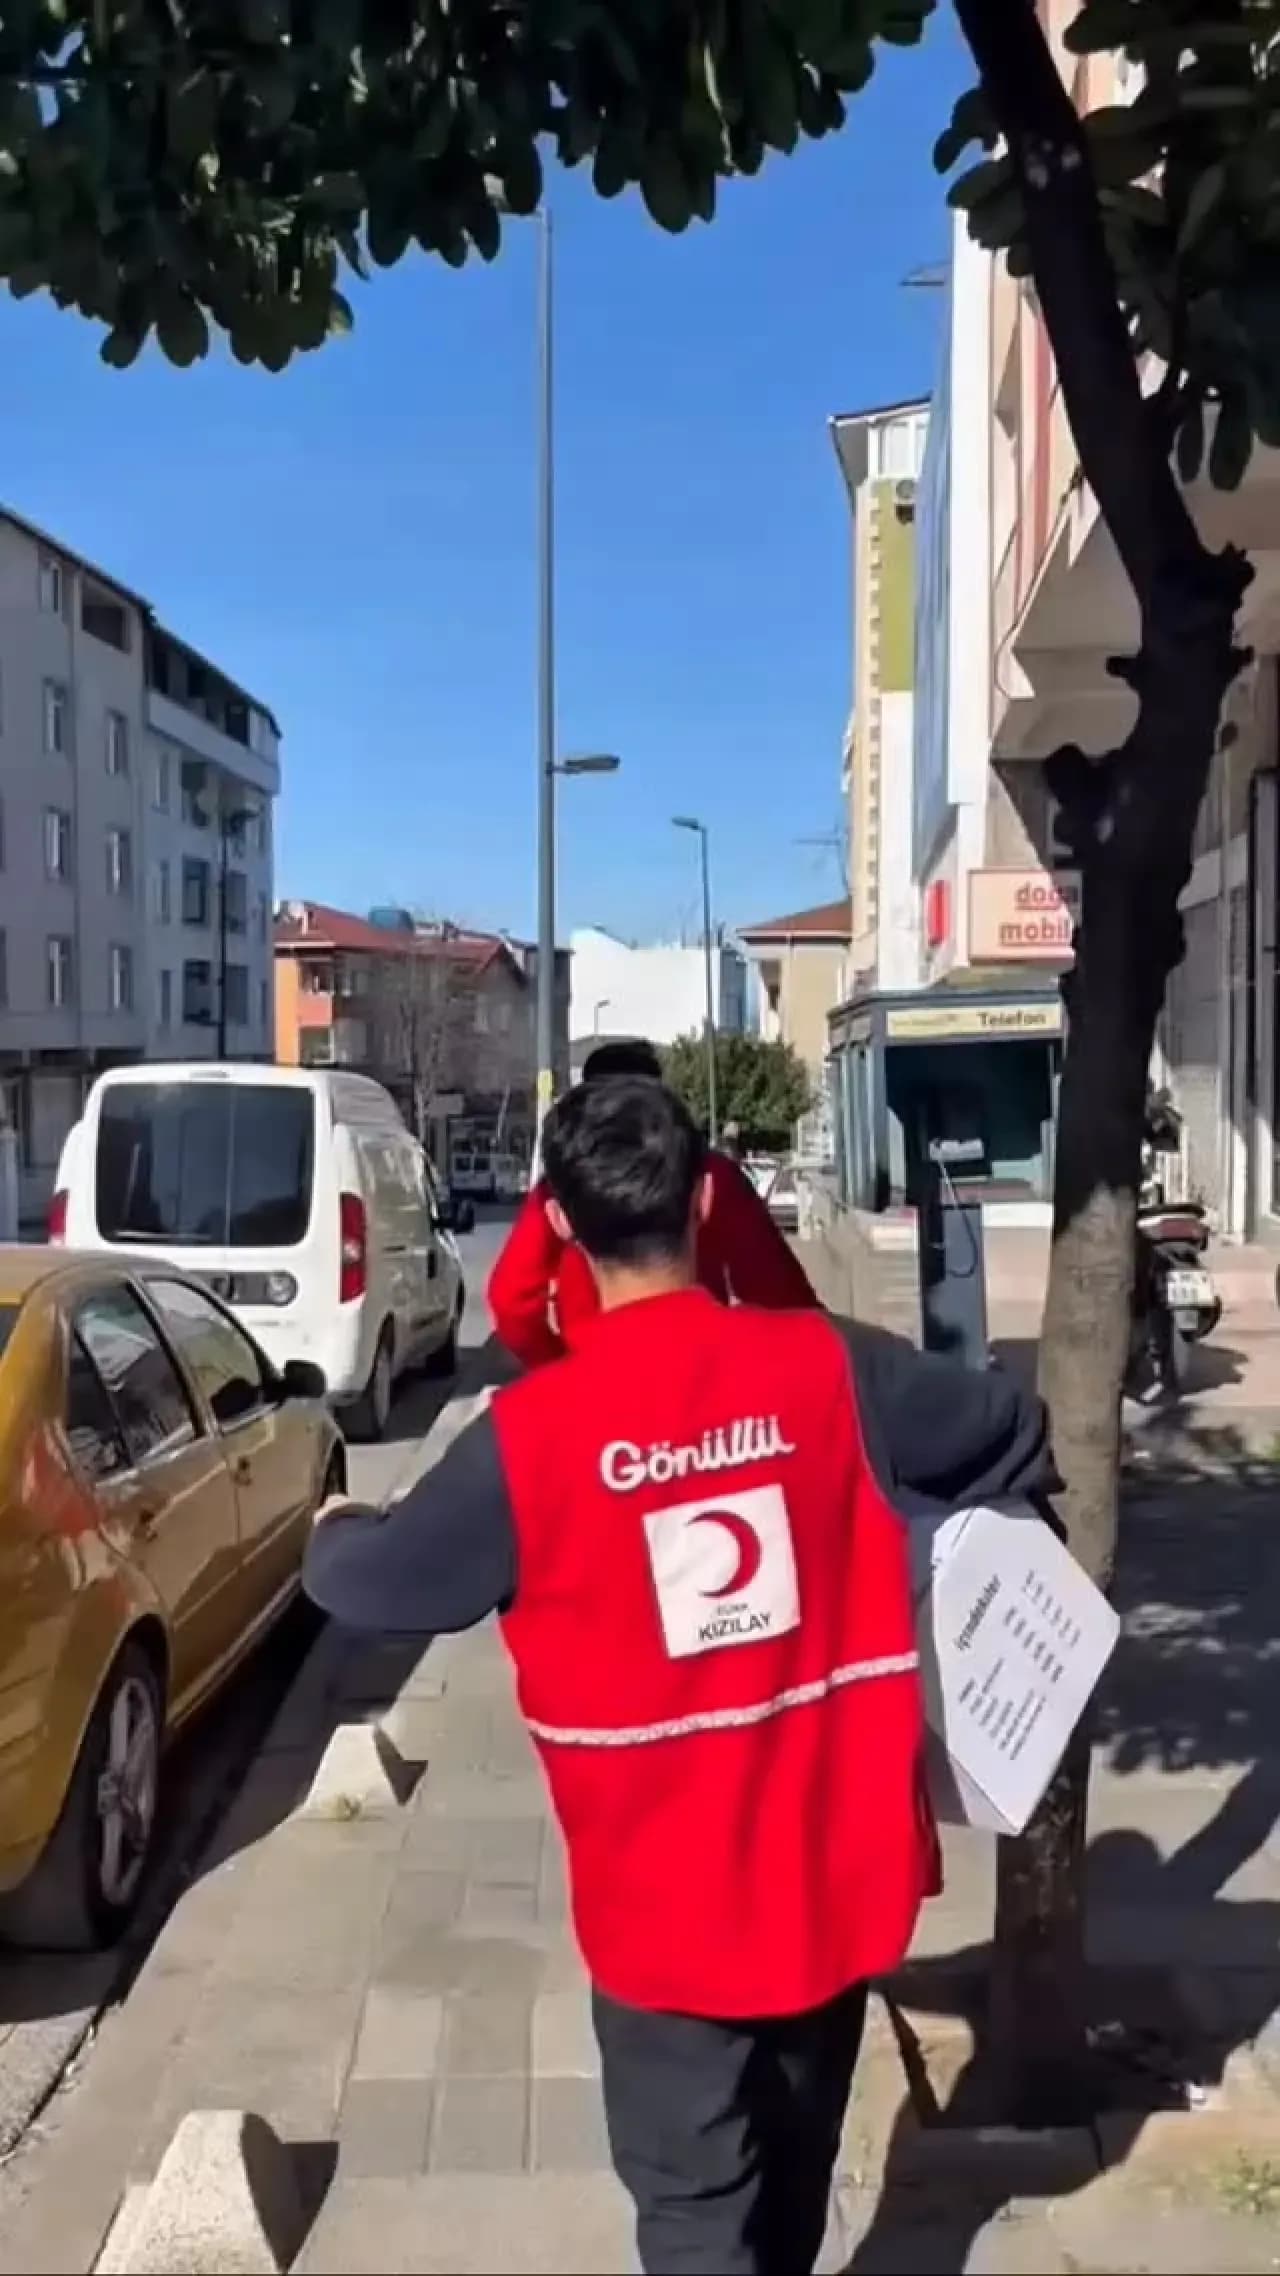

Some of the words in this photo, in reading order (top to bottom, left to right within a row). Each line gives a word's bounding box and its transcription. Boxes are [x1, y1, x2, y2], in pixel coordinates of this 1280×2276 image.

[978, 1010, 1046, 1026] Telefon
[600, 1415, 796, 1491] Gönüllü
[699, 1613, 771, 1641] KIZILAY
